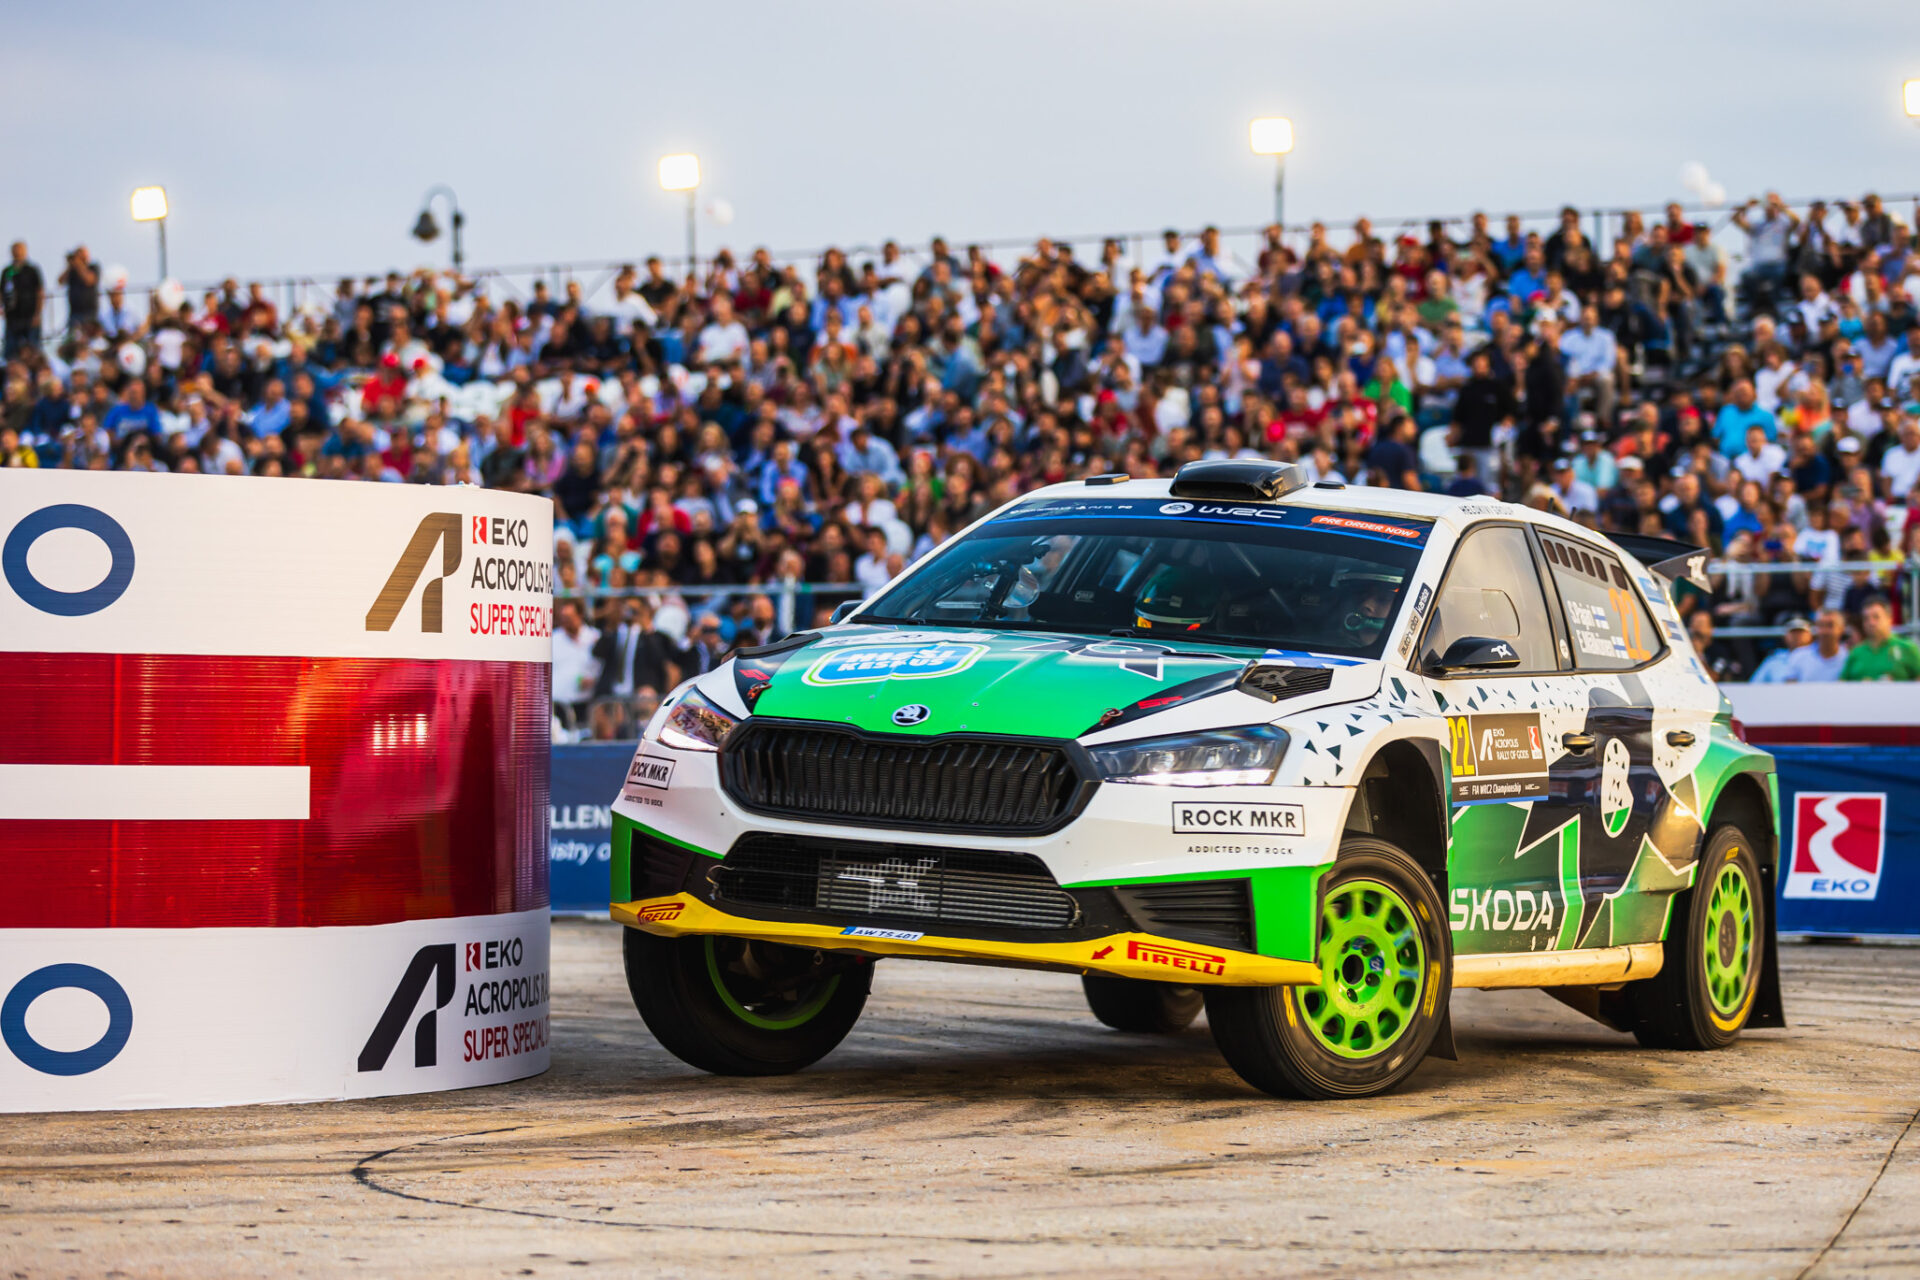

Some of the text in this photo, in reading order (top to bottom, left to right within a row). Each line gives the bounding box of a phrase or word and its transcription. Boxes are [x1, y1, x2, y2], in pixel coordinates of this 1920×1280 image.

[1198, 505, 1288, 519] WRC
[1319, 517, 1414, 537] PRE ORDER NOW
[492, 517, 529, 548] EKO
[471, 557, 544, 592] ACROPOLIS
[470, 602, 516, 636] SUPER
[519, 604, 549, 638] SPECIAL
[1608, 587, 1652, 662] 22
[1447, 716, 1476, 777] 22
[1182, 809, 1296, 828] ROCK MKR
[1187, 846, 1293, 855] ADDICTED TO ROCK
[1810, 878, 1871, 894] EKO
[636, 902, 686, 925] PIRELLI
[485, 937, 523, 970] EKO
[1127, 940, 1226, 976] PIRELLI
[464, 973, 540, 1017] ACROPOLIS
[464, 1025, 511, 1063] SUPER
[513, 1017, 545, 1055] SPECIAL
